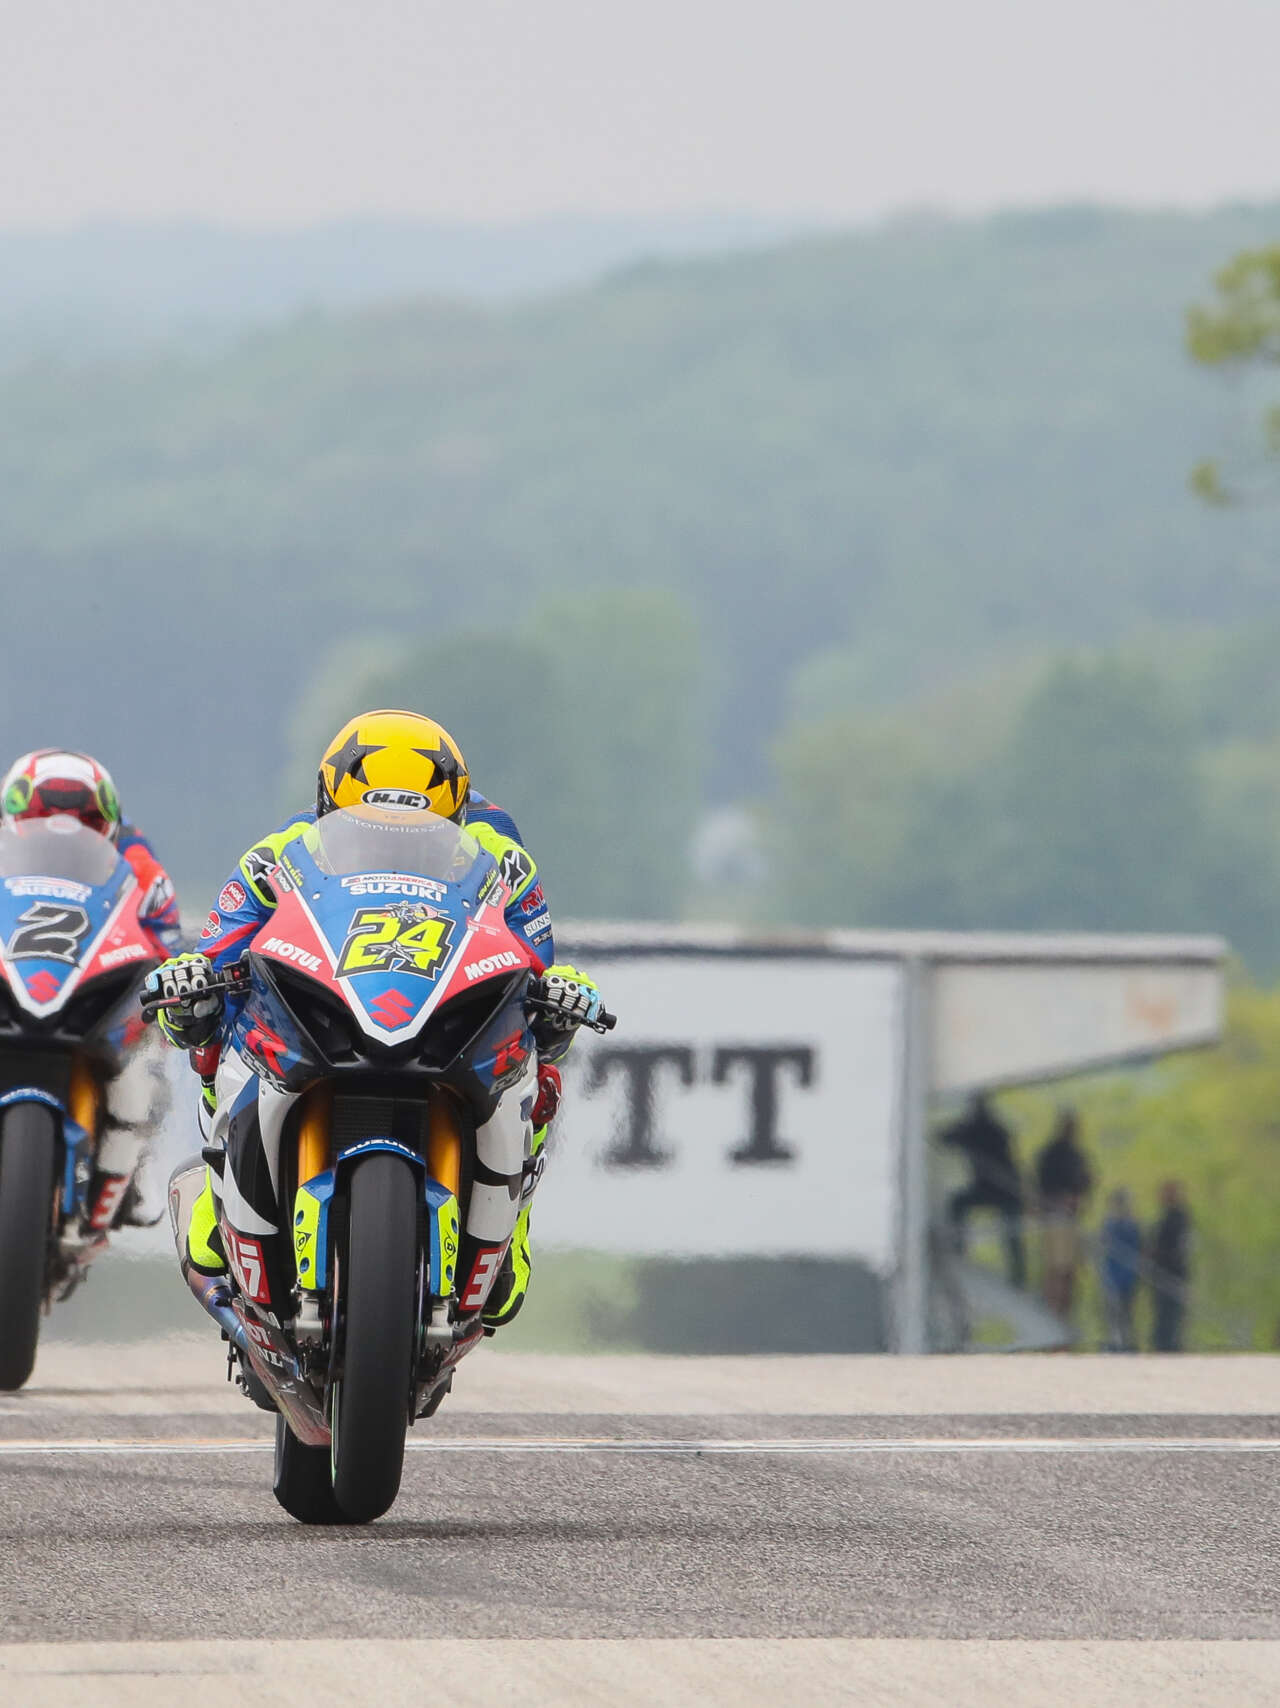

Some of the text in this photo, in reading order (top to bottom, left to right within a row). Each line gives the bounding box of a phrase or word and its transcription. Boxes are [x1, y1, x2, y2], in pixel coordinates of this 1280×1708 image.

[370, 792, 421, 808] HJC
[349, 881, 443, 903] SUZUKI
[6, 901, 90, 966] 2
[525, 914, 551, 935] SUNS
[261, 937, 323, 972] MOTUL
[337, 909, 455, 980] 24
[463, 951, 522, 981] MOTUL
